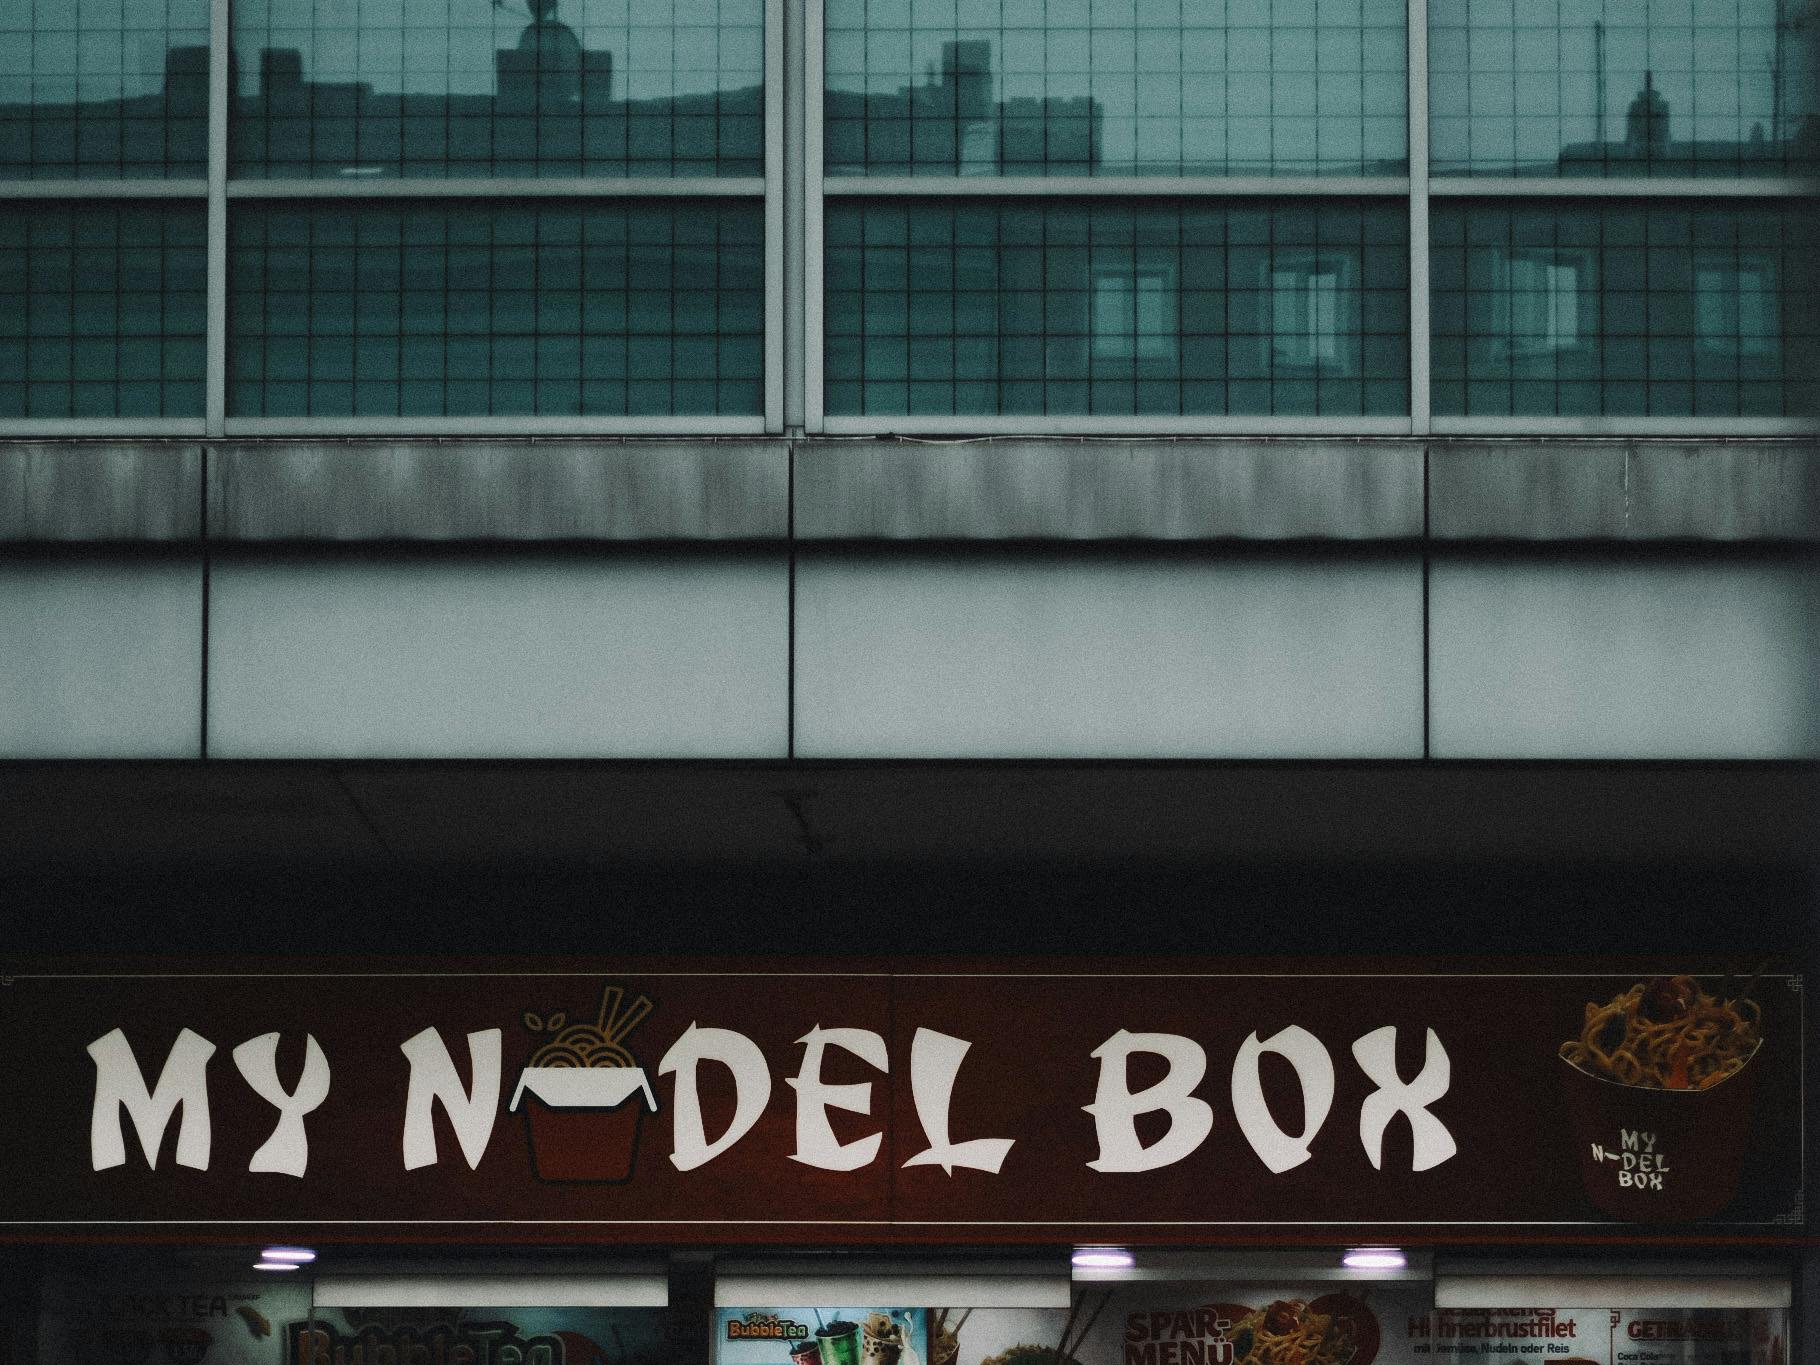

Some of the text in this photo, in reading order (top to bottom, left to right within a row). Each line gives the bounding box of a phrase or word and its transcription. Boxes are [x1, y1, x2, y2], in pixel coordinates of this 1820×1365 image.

[86, 1026, 331, 1178] MY
[1081, 1024, 1457, 1174] BOX
[1620, 1128, 1656, 1153] MY
[1619, 1170, 1663, 1190] BOX
[729, 1321, 807, 1338] BubbleTea
[1126, 1308, 1231, 1342] SPAR-
[1482, 1343, 1518, 1354] Nudeln
[1520, 1343, 1544, 1354] oder
[1547, 1343, 1570, 1354] Reis
